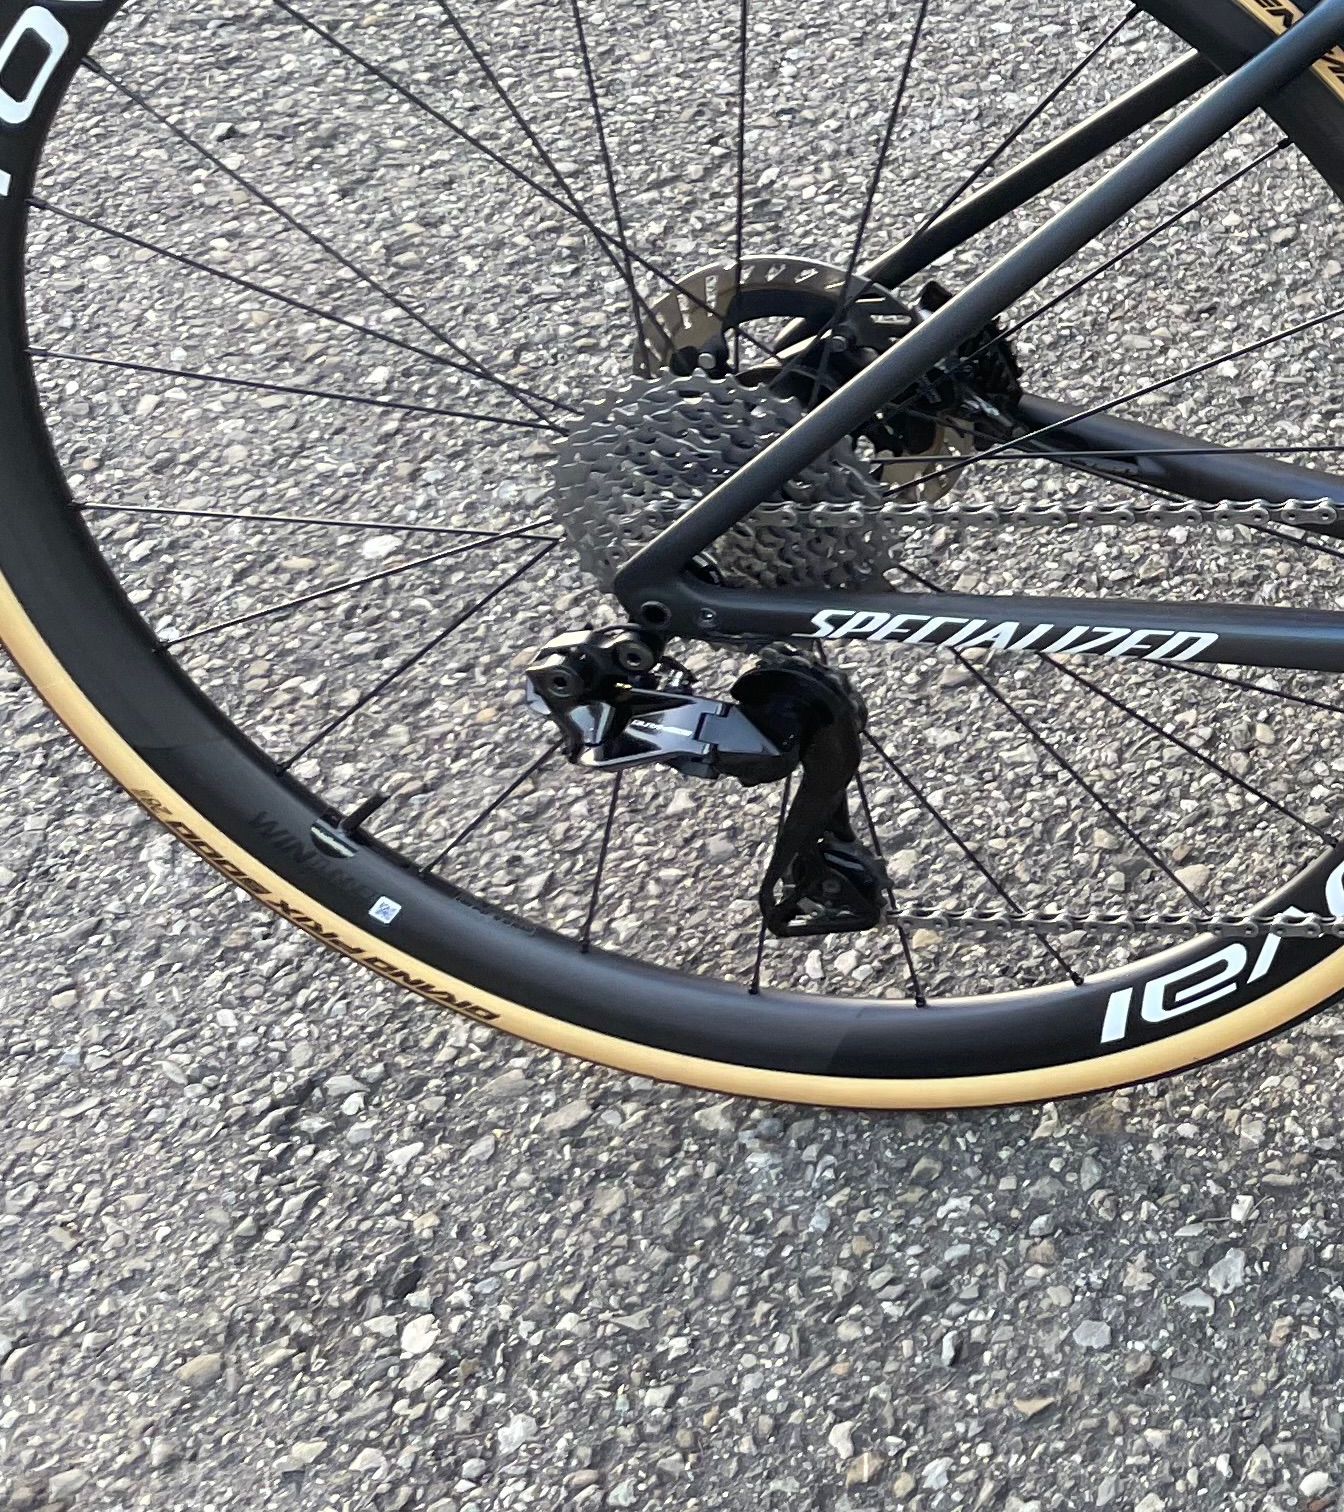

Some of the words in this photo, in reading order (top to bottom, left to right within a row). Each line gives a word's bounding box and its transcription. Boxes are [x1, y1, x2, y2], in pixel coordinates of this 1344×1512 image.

[795, 609, 1219, 662] SPECIALIZED
[168, 820, 272, 892] 5000
[264, 897, 366, 957] PRIX
[363, 956, 501, 1021] GRAND
